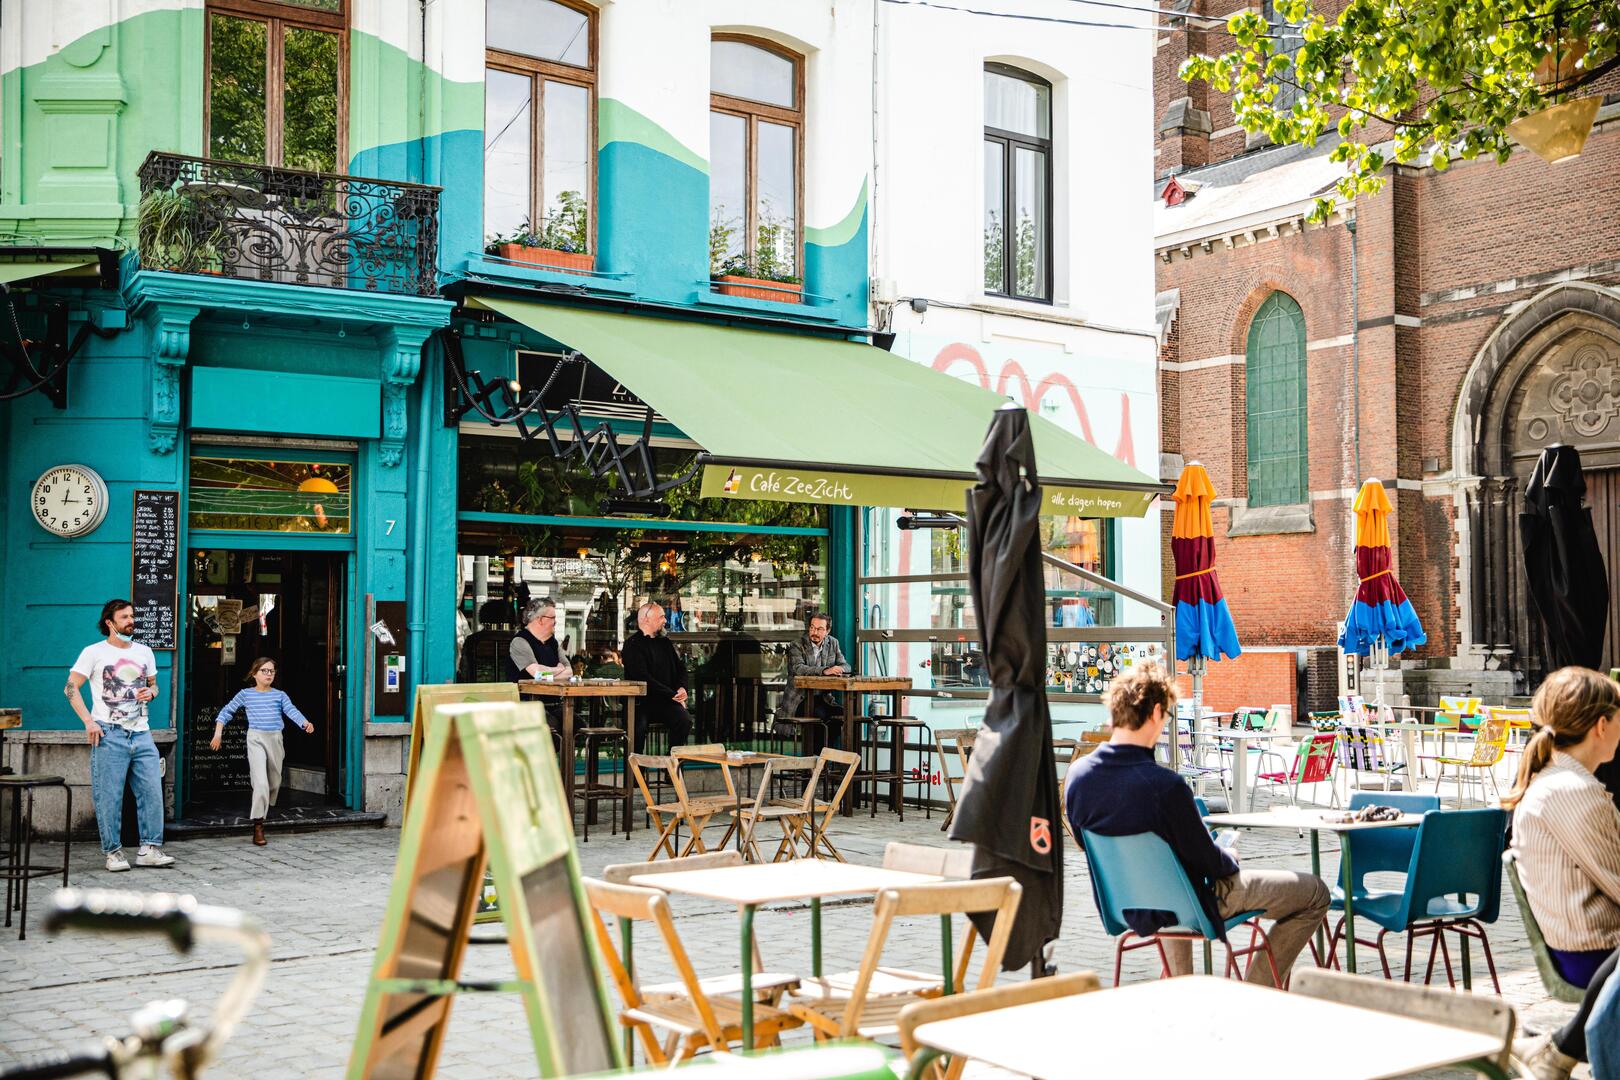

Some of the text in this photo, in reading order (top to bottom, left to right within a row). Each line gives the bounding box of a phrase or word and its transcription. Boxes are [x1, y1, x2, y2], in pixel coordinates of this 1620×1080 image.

[64, 473, 70, 481] 12
[43, 485, 50, 493] 10
[750, 472, 853, 500] Café ZeeZicht
[39, 497, 46, 505] 9
[1051, 492, 1122, 512] alle dagen hopen
[386, 520, 396, 536] 7
